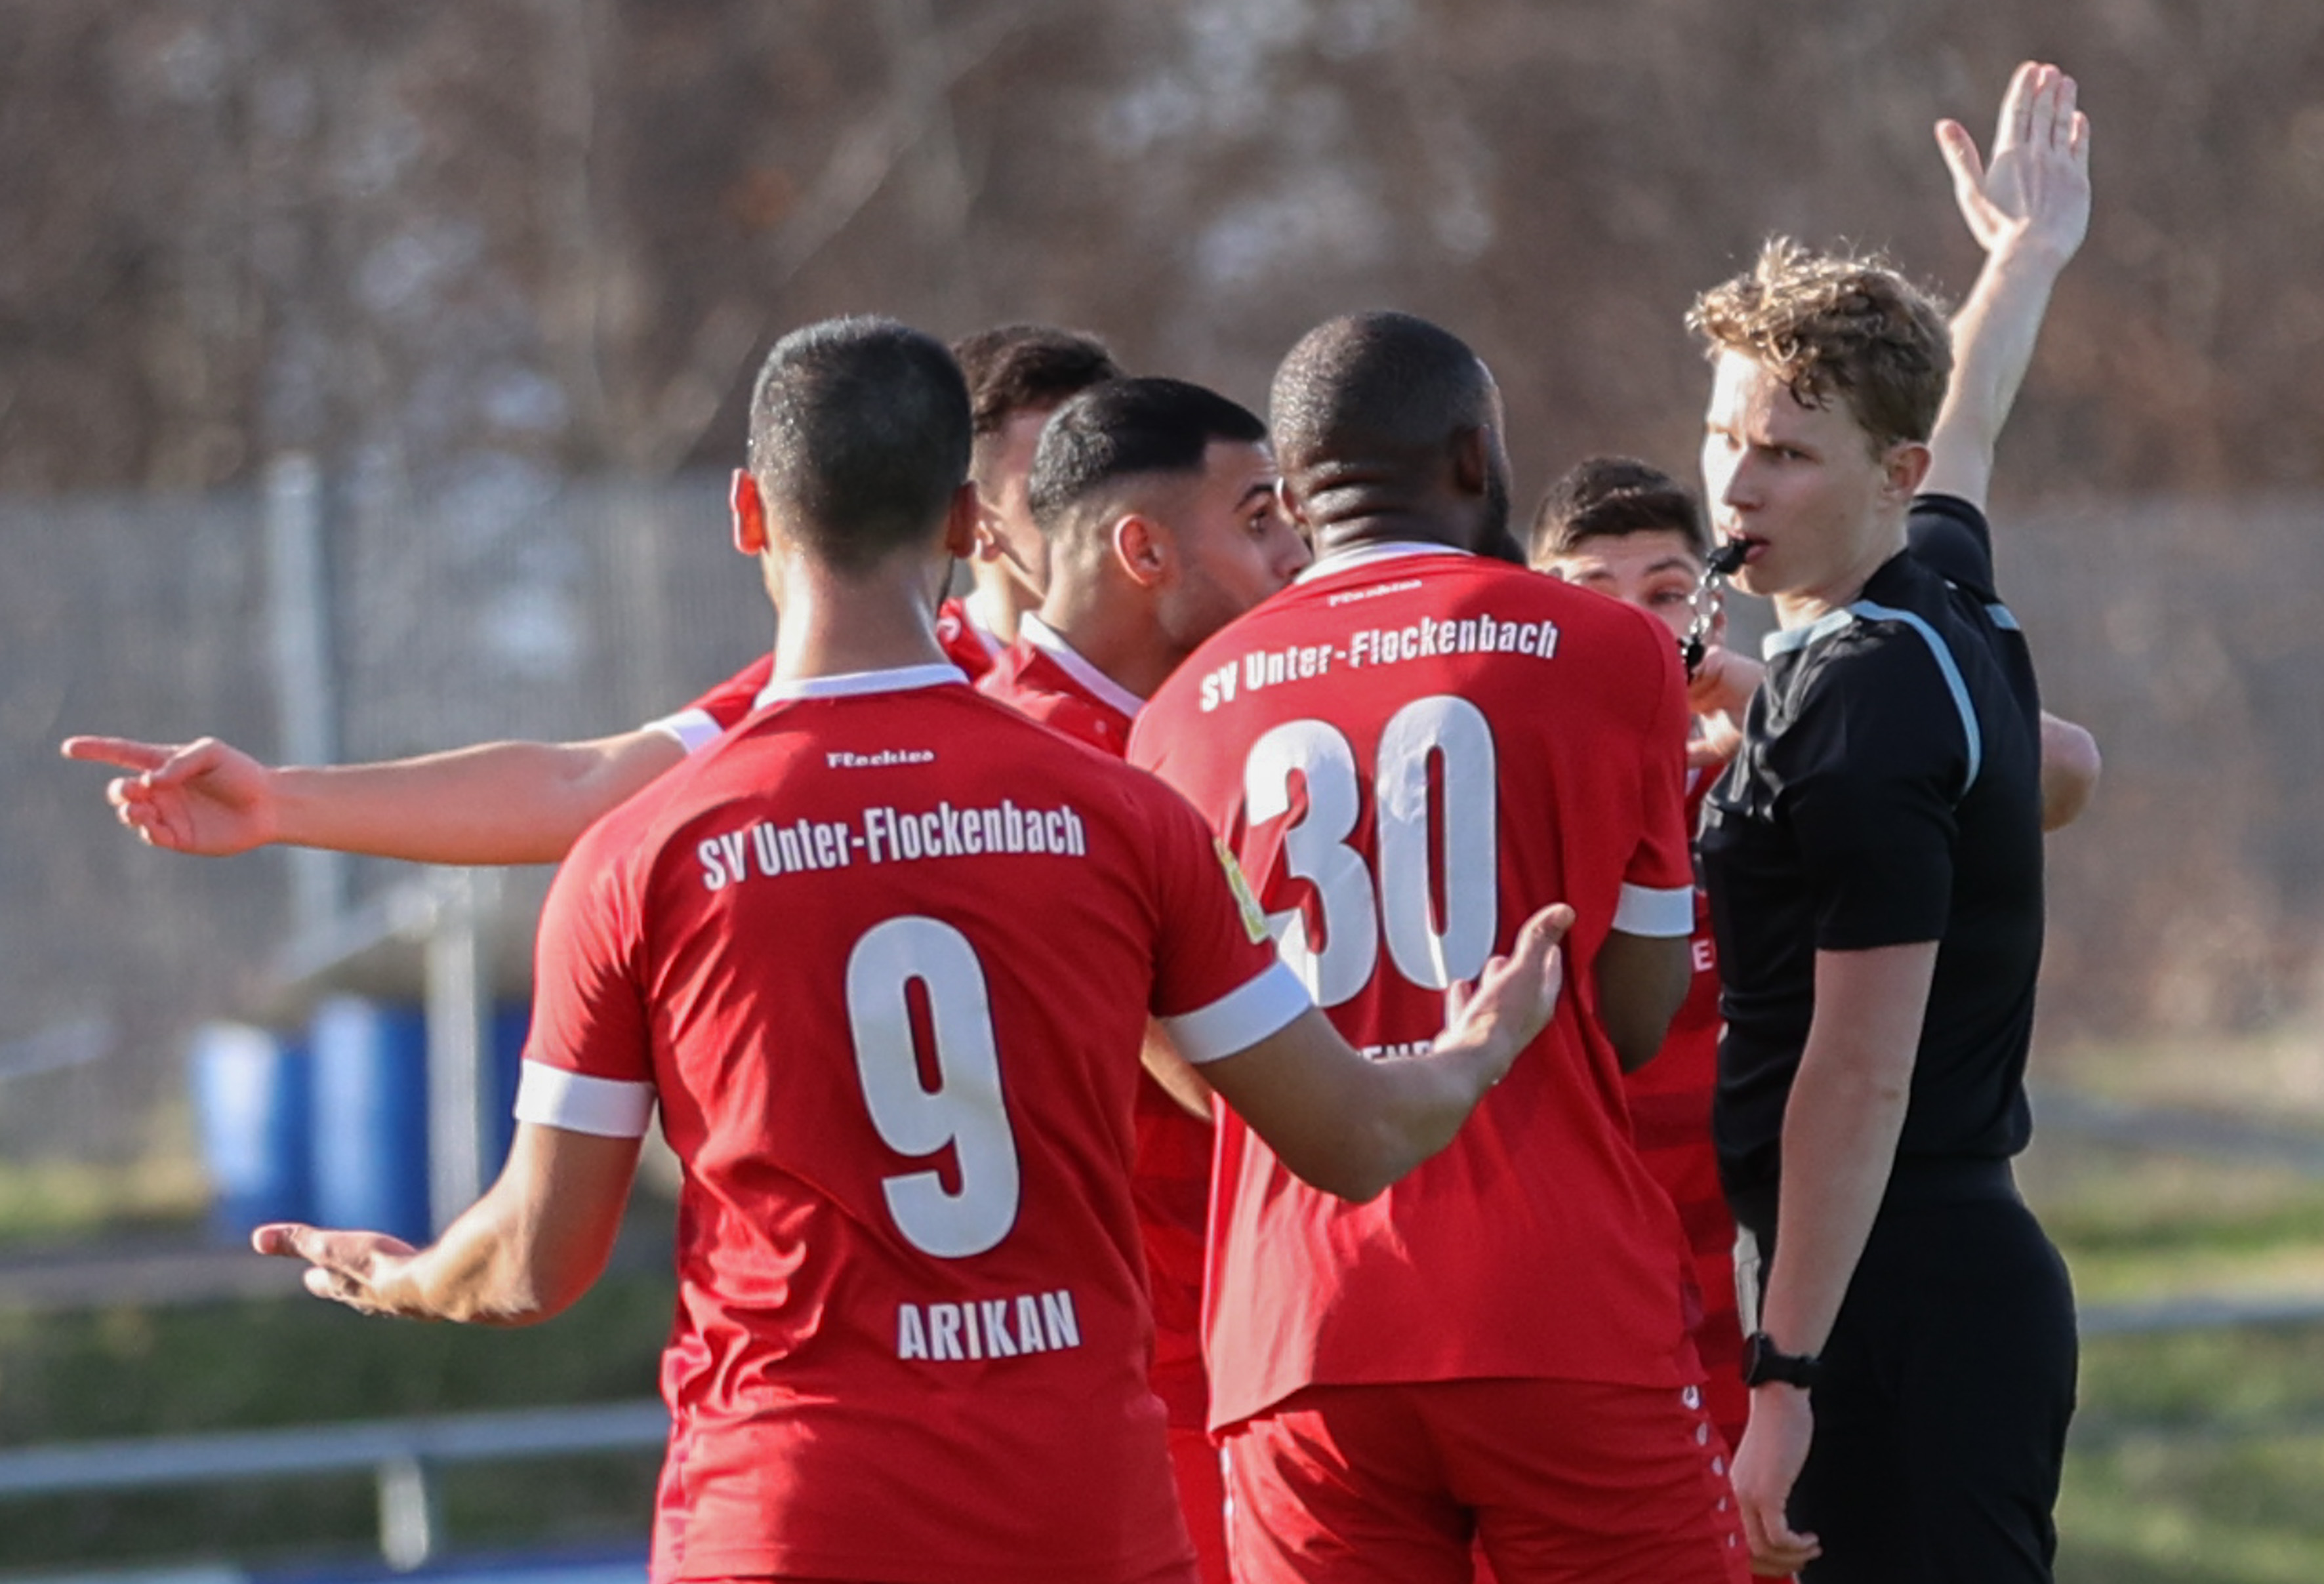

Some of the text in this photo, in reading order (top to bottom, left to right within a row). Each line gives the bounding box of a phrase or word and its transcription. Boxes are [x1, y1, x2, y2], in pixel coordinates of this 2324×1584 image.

[1199, 613, 1559, 713] SV Unter-Flockenbach
[697, 800, 1086, 891] SV Unter-Flockenbach
[1244, 694, 1498, 1009] 30
[845, 914, 1020, 1259] 9
[897, 1290, 1081, 1361] ARIKAN
